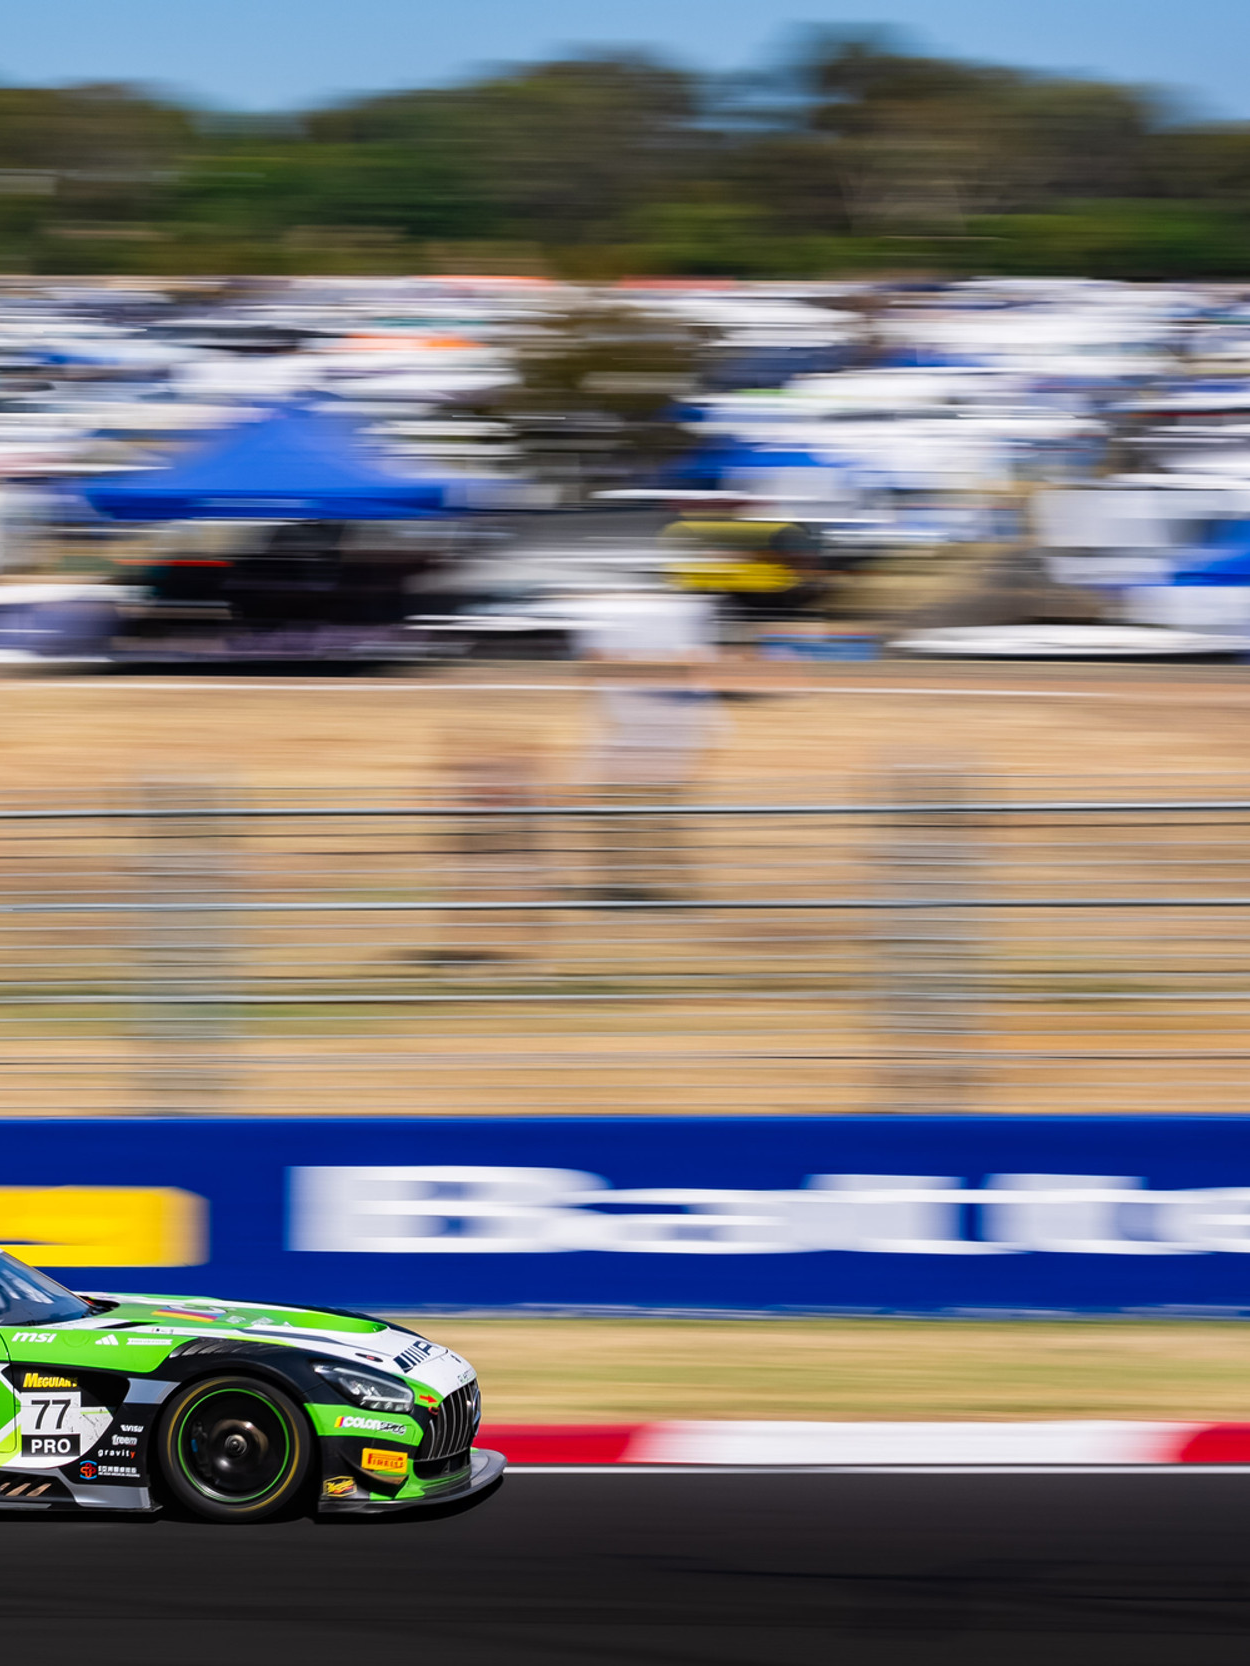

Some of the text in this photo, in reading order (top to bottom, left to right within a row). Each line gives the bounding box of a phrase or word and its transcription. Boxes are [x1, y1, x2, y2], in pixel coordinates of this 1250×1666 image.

[31, 1399, 71, 1430] 77
[31, 1438, 71, 1454] PRO
[98, 1448, 135, 1459] gravity
